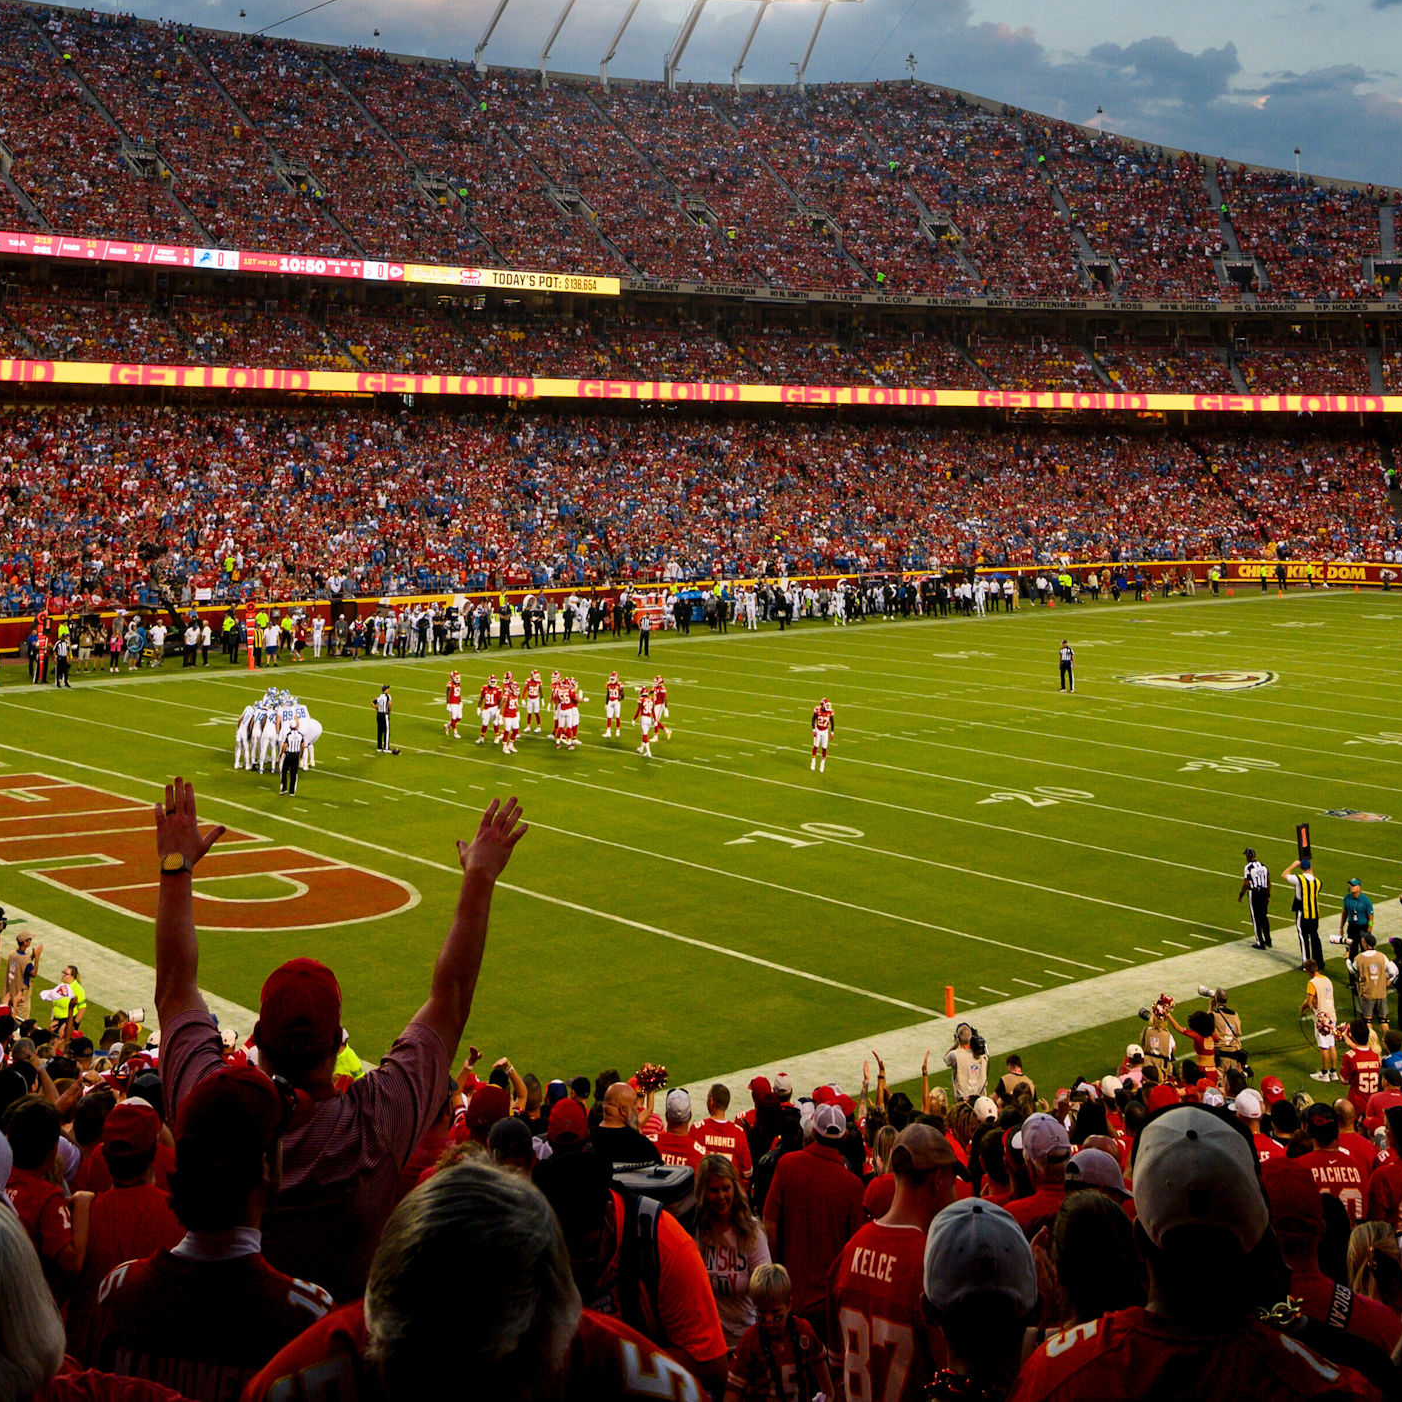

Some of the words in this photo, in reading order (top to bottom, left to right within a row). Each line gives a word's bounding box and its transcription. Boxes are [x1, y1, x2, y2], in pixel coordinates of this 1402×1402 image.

[134, 253, 140, 261] 7
[279, 257, 326, 273] 10:50
[492, 272, 536, 287] TODAY'S
[539, 276, 562, 288] POT:
[644, 283, 679, 292] DELANEY
[694, 285, 715, 294] JACK
[716, 286, 756, 296] STEADMAN
[788, 291, 809, 299] SMITH
[893, 296, 912, 304] CULP
[987, 299, 1014, 307] MARTY
[1015, 300, 1087, 308] SCHOTTENHEIMER
[1120, 302, 1143, 310] ROSS
[1180, 303, 1217, 311] SHIELDS
[1332, 303, 1368, 311] HOLMES
[109, 364, 195, 387] GET
[203, 367, 310, 390] LOUD
[357, 373, 431, 394] GET
[438, 375, 535, 396] LOUD
[577, 379, 645, 400] GET
[652, 381, 741, 401] LOUD
[780, 385, 844, 404] GET
[851, 387, 937, 406] LOUD
[977, 391, 1046, 409] GET
[1052, 393, 1148, 410] LOUD
[1193, 395, 1270, 411] GET
[1278, 395, 1385, 412] LOUD
[1238, 565, 1280, 579] CHIEF
[484, 693, 495, 705] 91
[282, 710, 293, 721] 89
[817, 715, 829, 727] 27
[990, 786, 1095, 807] 20
[743, 822, 865, 848] 10
[1358, 1071, 1378, 1094] 52
[705, 1134, 735, 1149] MAHOMES
[661, 1152, 688, 1167] KELCE
[1311, 1165, 1361, 1183] PACHECO
[703, 1244, 748, 1271] NSAS
[850, 1245, 898, 1283] KELCE
[1328, 1282, 1352, 1329] ERICAN
[839, 1306, 915, 1402] 87
